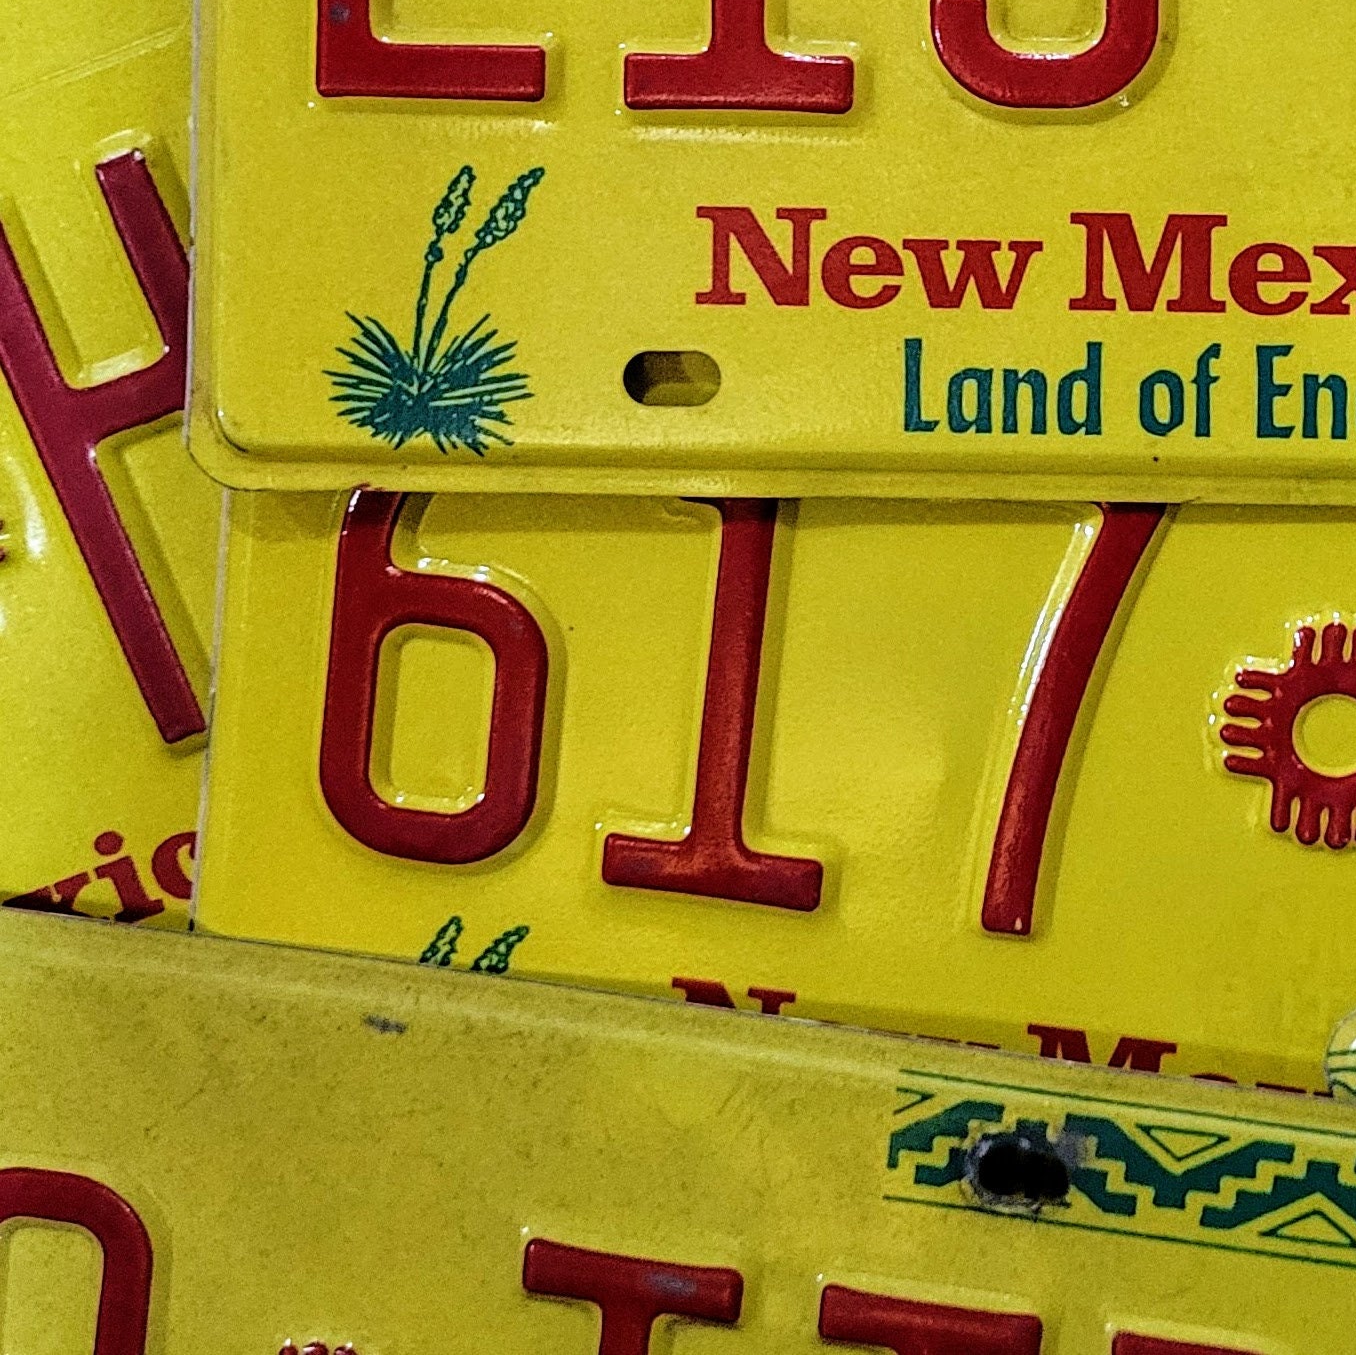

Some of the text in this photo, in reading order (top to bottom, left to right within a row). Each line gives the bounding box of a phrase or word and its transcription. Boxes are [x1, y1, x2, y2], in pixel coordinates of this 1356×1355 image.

[696, 207, 1042, 309] New
[904, 338, 1103, 435] Land
[1139, 343, 1222, 437] of
